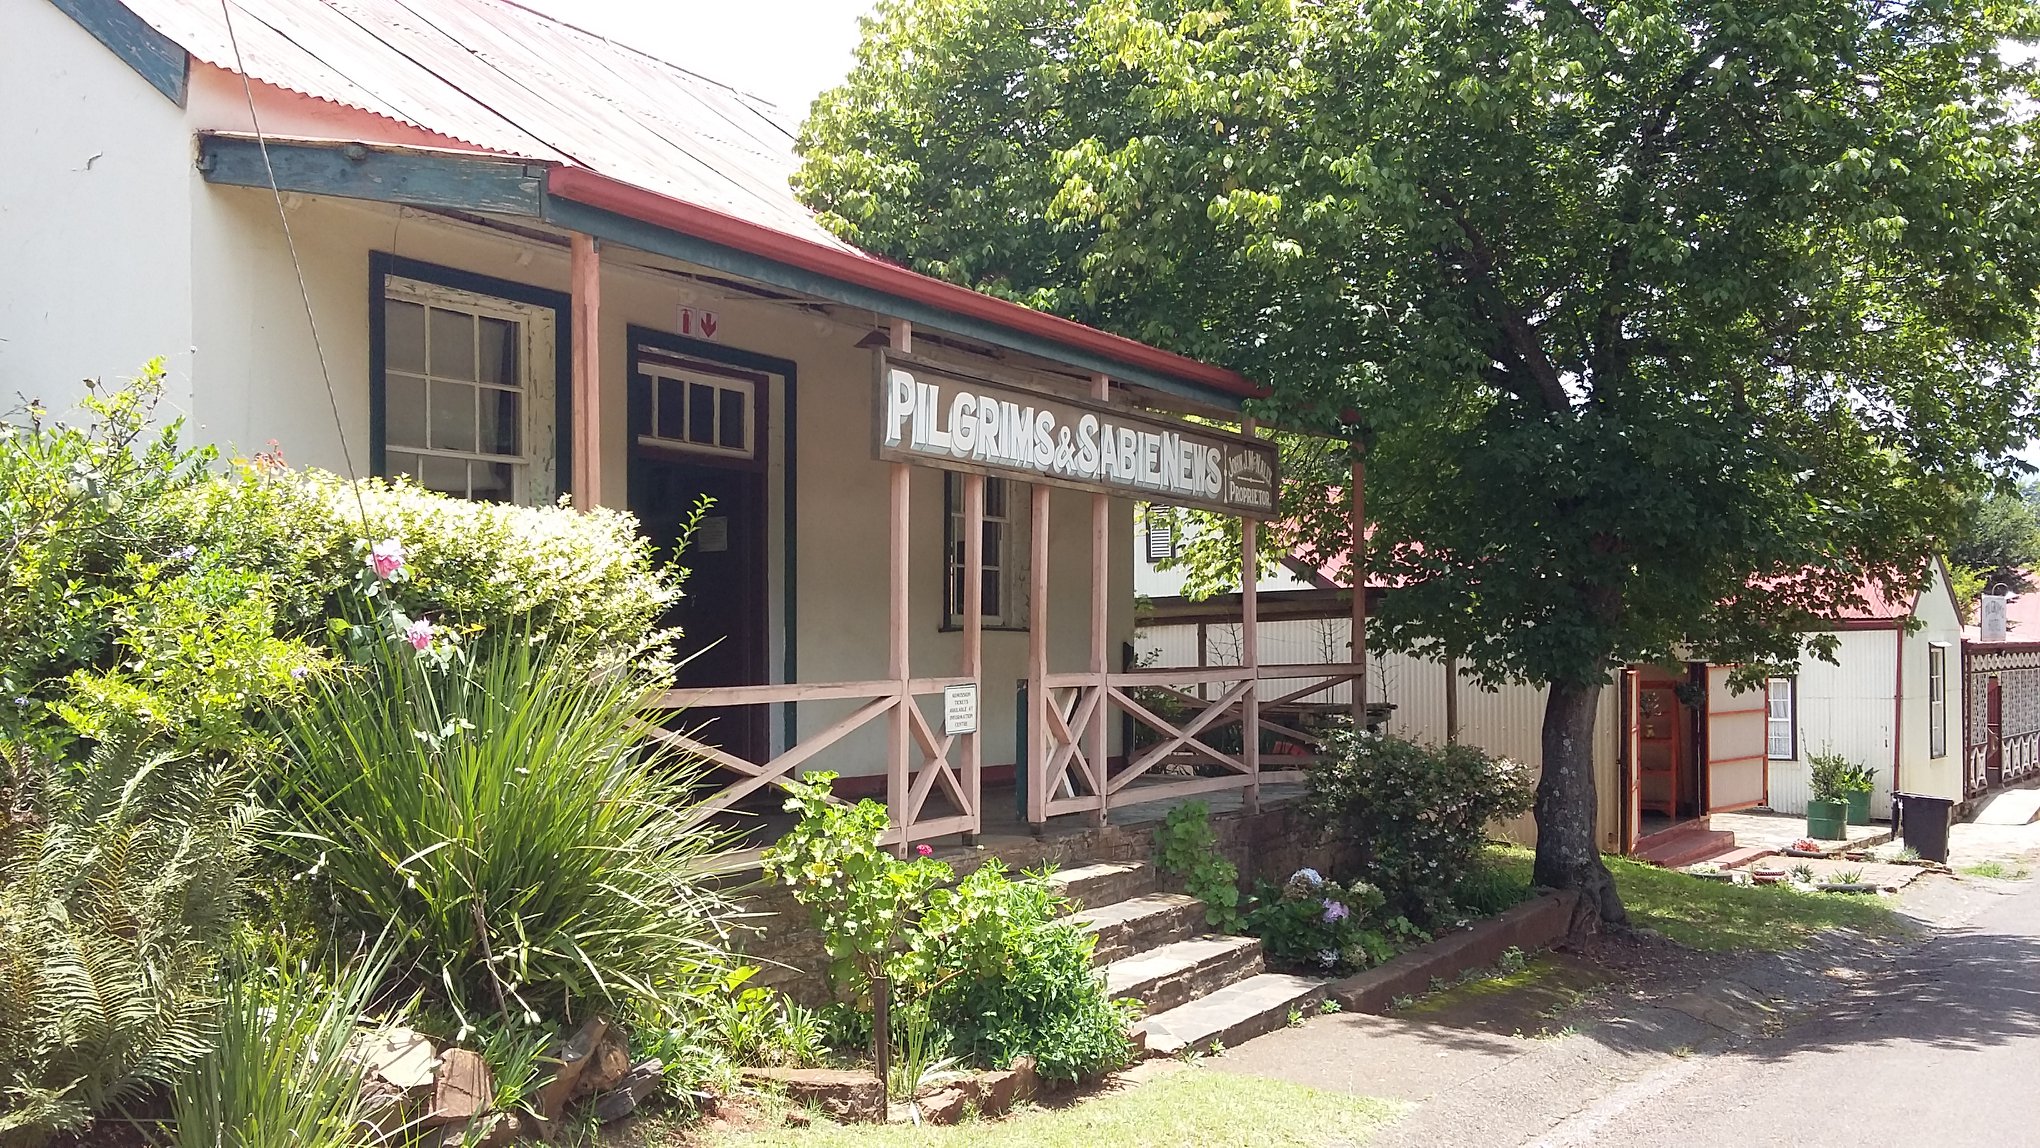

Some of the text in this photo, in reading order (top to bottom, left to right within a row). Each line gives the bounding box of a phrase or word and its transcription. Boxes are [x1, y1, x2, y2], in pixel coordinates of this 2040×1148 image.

[884, 368, 1222, 499] PILGRIMS & SABIE NEWS
